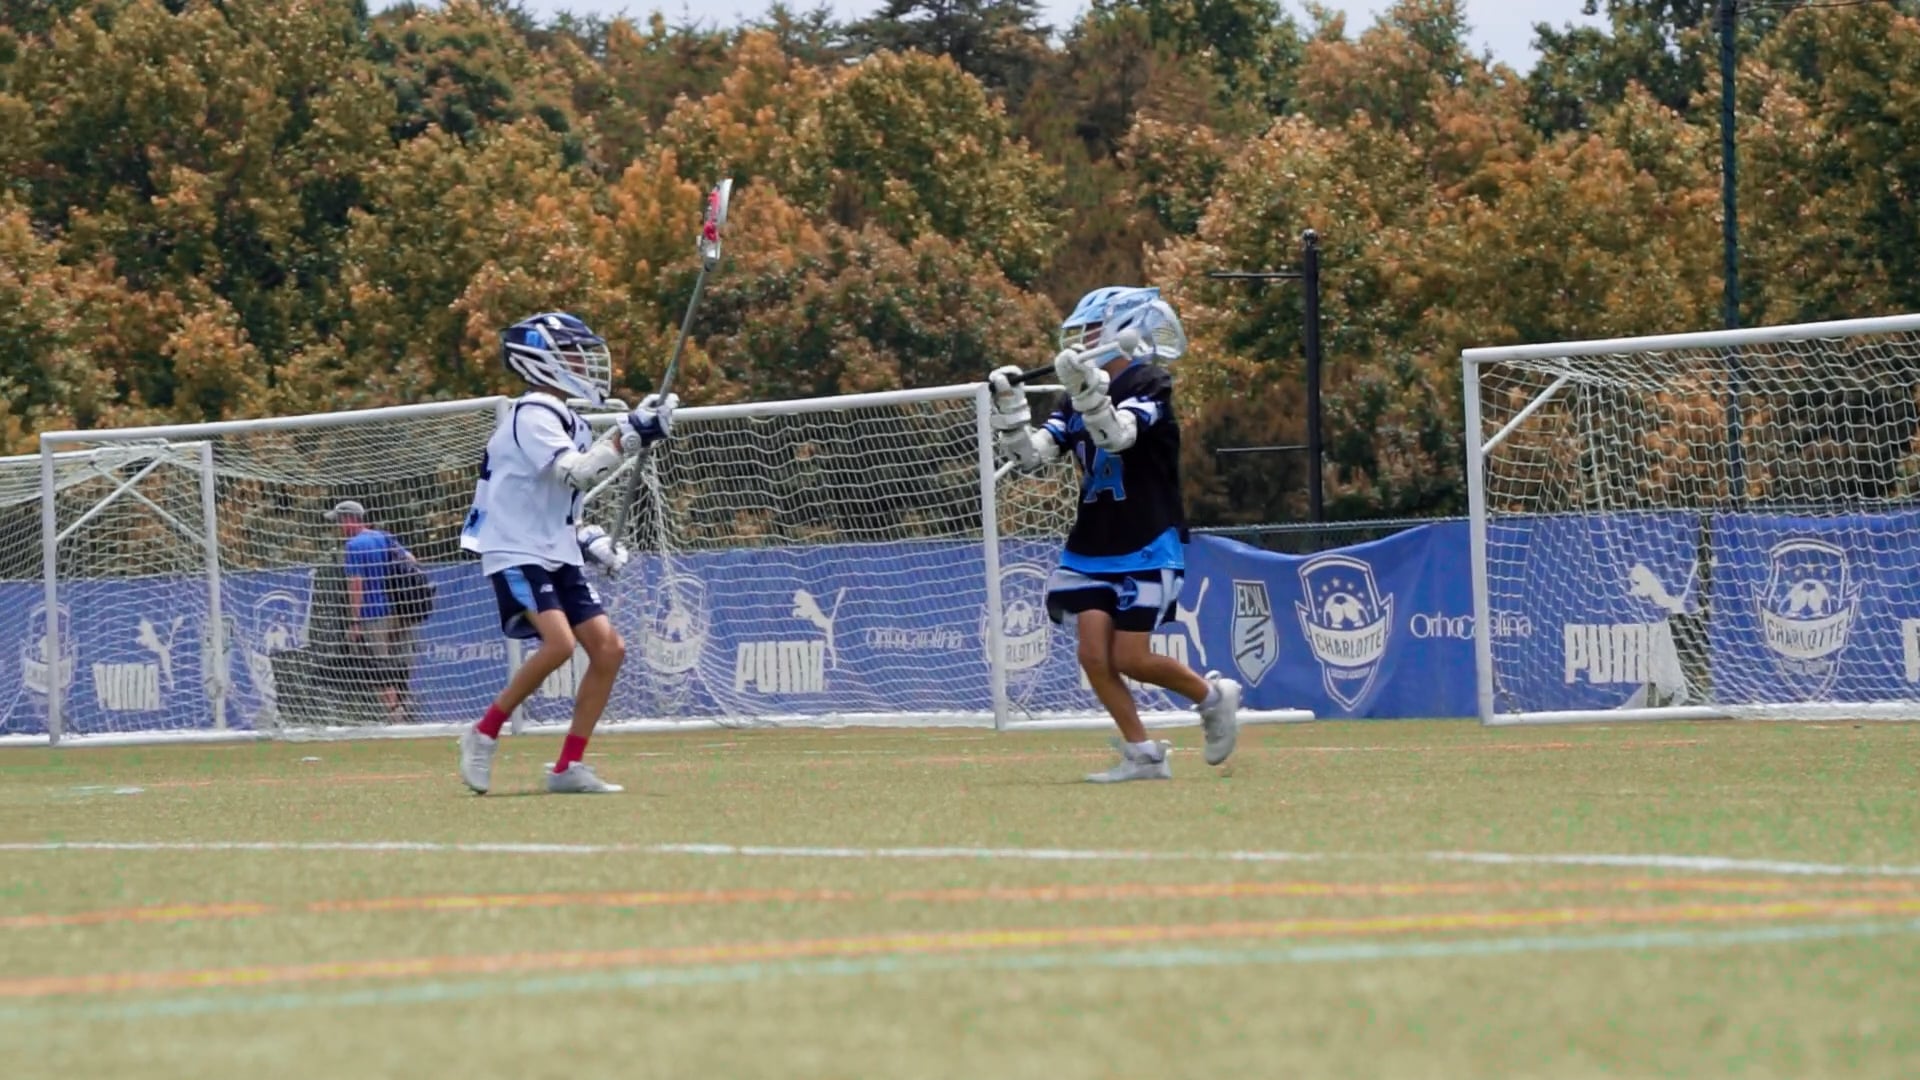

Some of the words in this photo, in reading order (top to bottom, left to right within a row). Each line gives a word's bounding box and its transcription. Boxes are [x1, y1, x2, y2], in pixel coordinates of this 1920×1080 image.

[1315, 627, 1382, 659] CHARLOTTE
[1410, 611, 1532, 640] OrthoColina
[736, 640, 824, 693] PUMA
[1564, 622, 1671, 684] PUM
